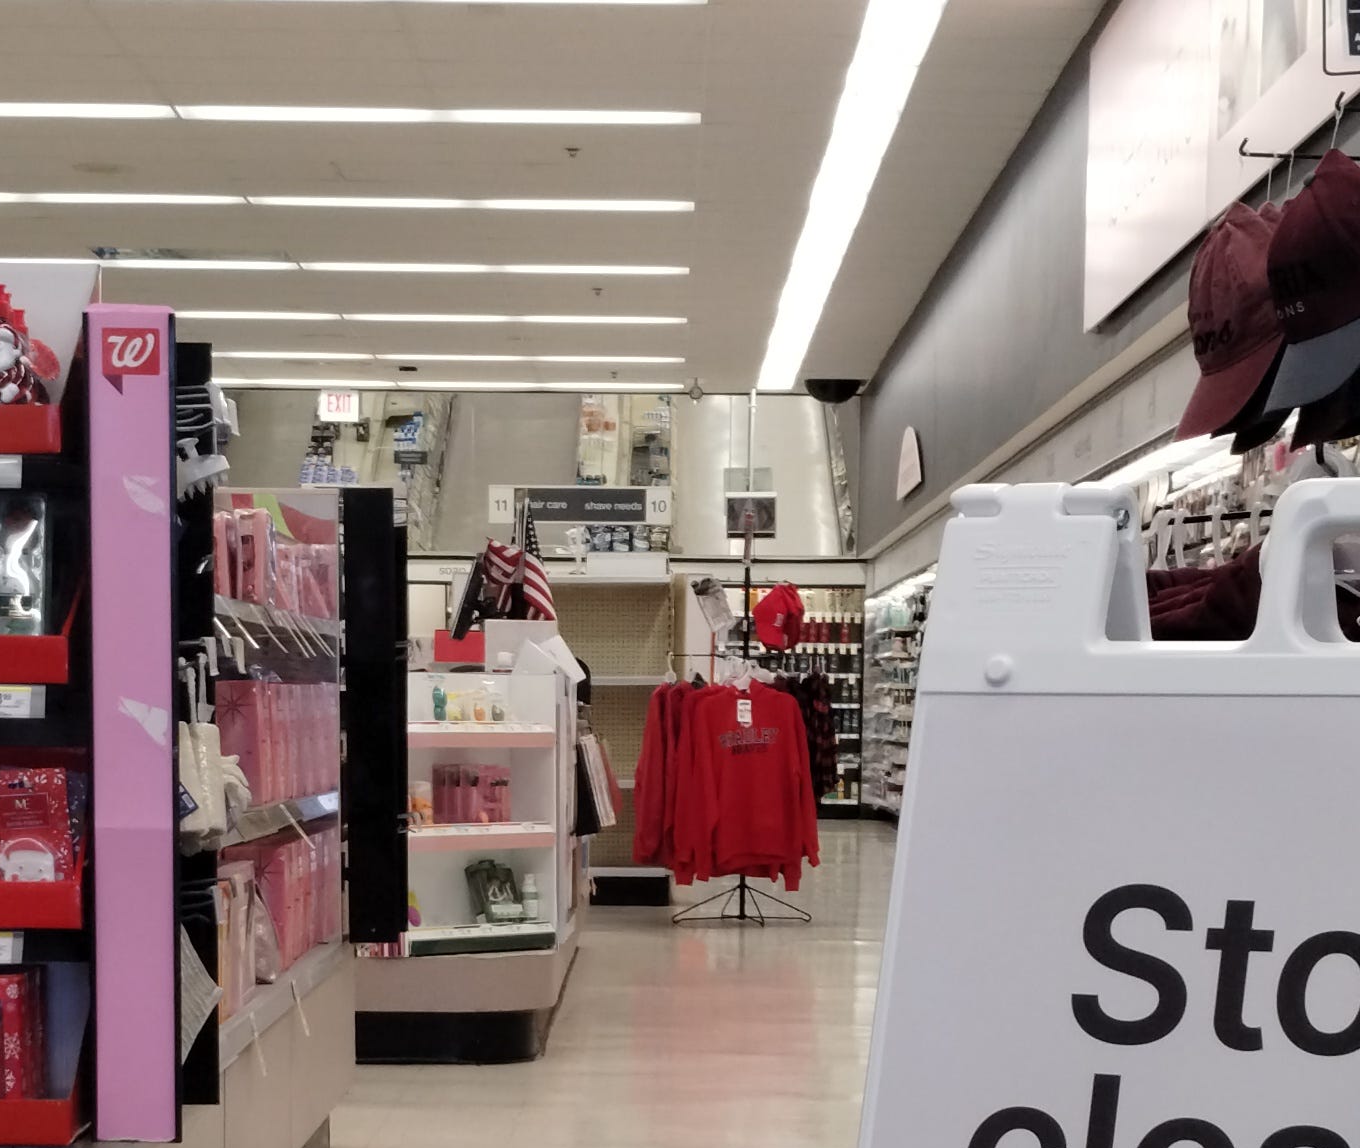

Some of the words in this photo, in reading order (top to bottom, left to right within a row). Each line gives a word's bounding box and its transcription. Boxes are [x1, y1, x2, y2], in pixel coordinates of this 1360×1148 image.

[97, 333, 155, 367] W
[327, 393, 351, 413] EXIT
[495, 500, 508, 511] 11
[546, 501, 568, 509] care
[584, 501, 612, 510] shave
[614, 502, 643, 511] needs
[651, 500, 667, 512] 10
